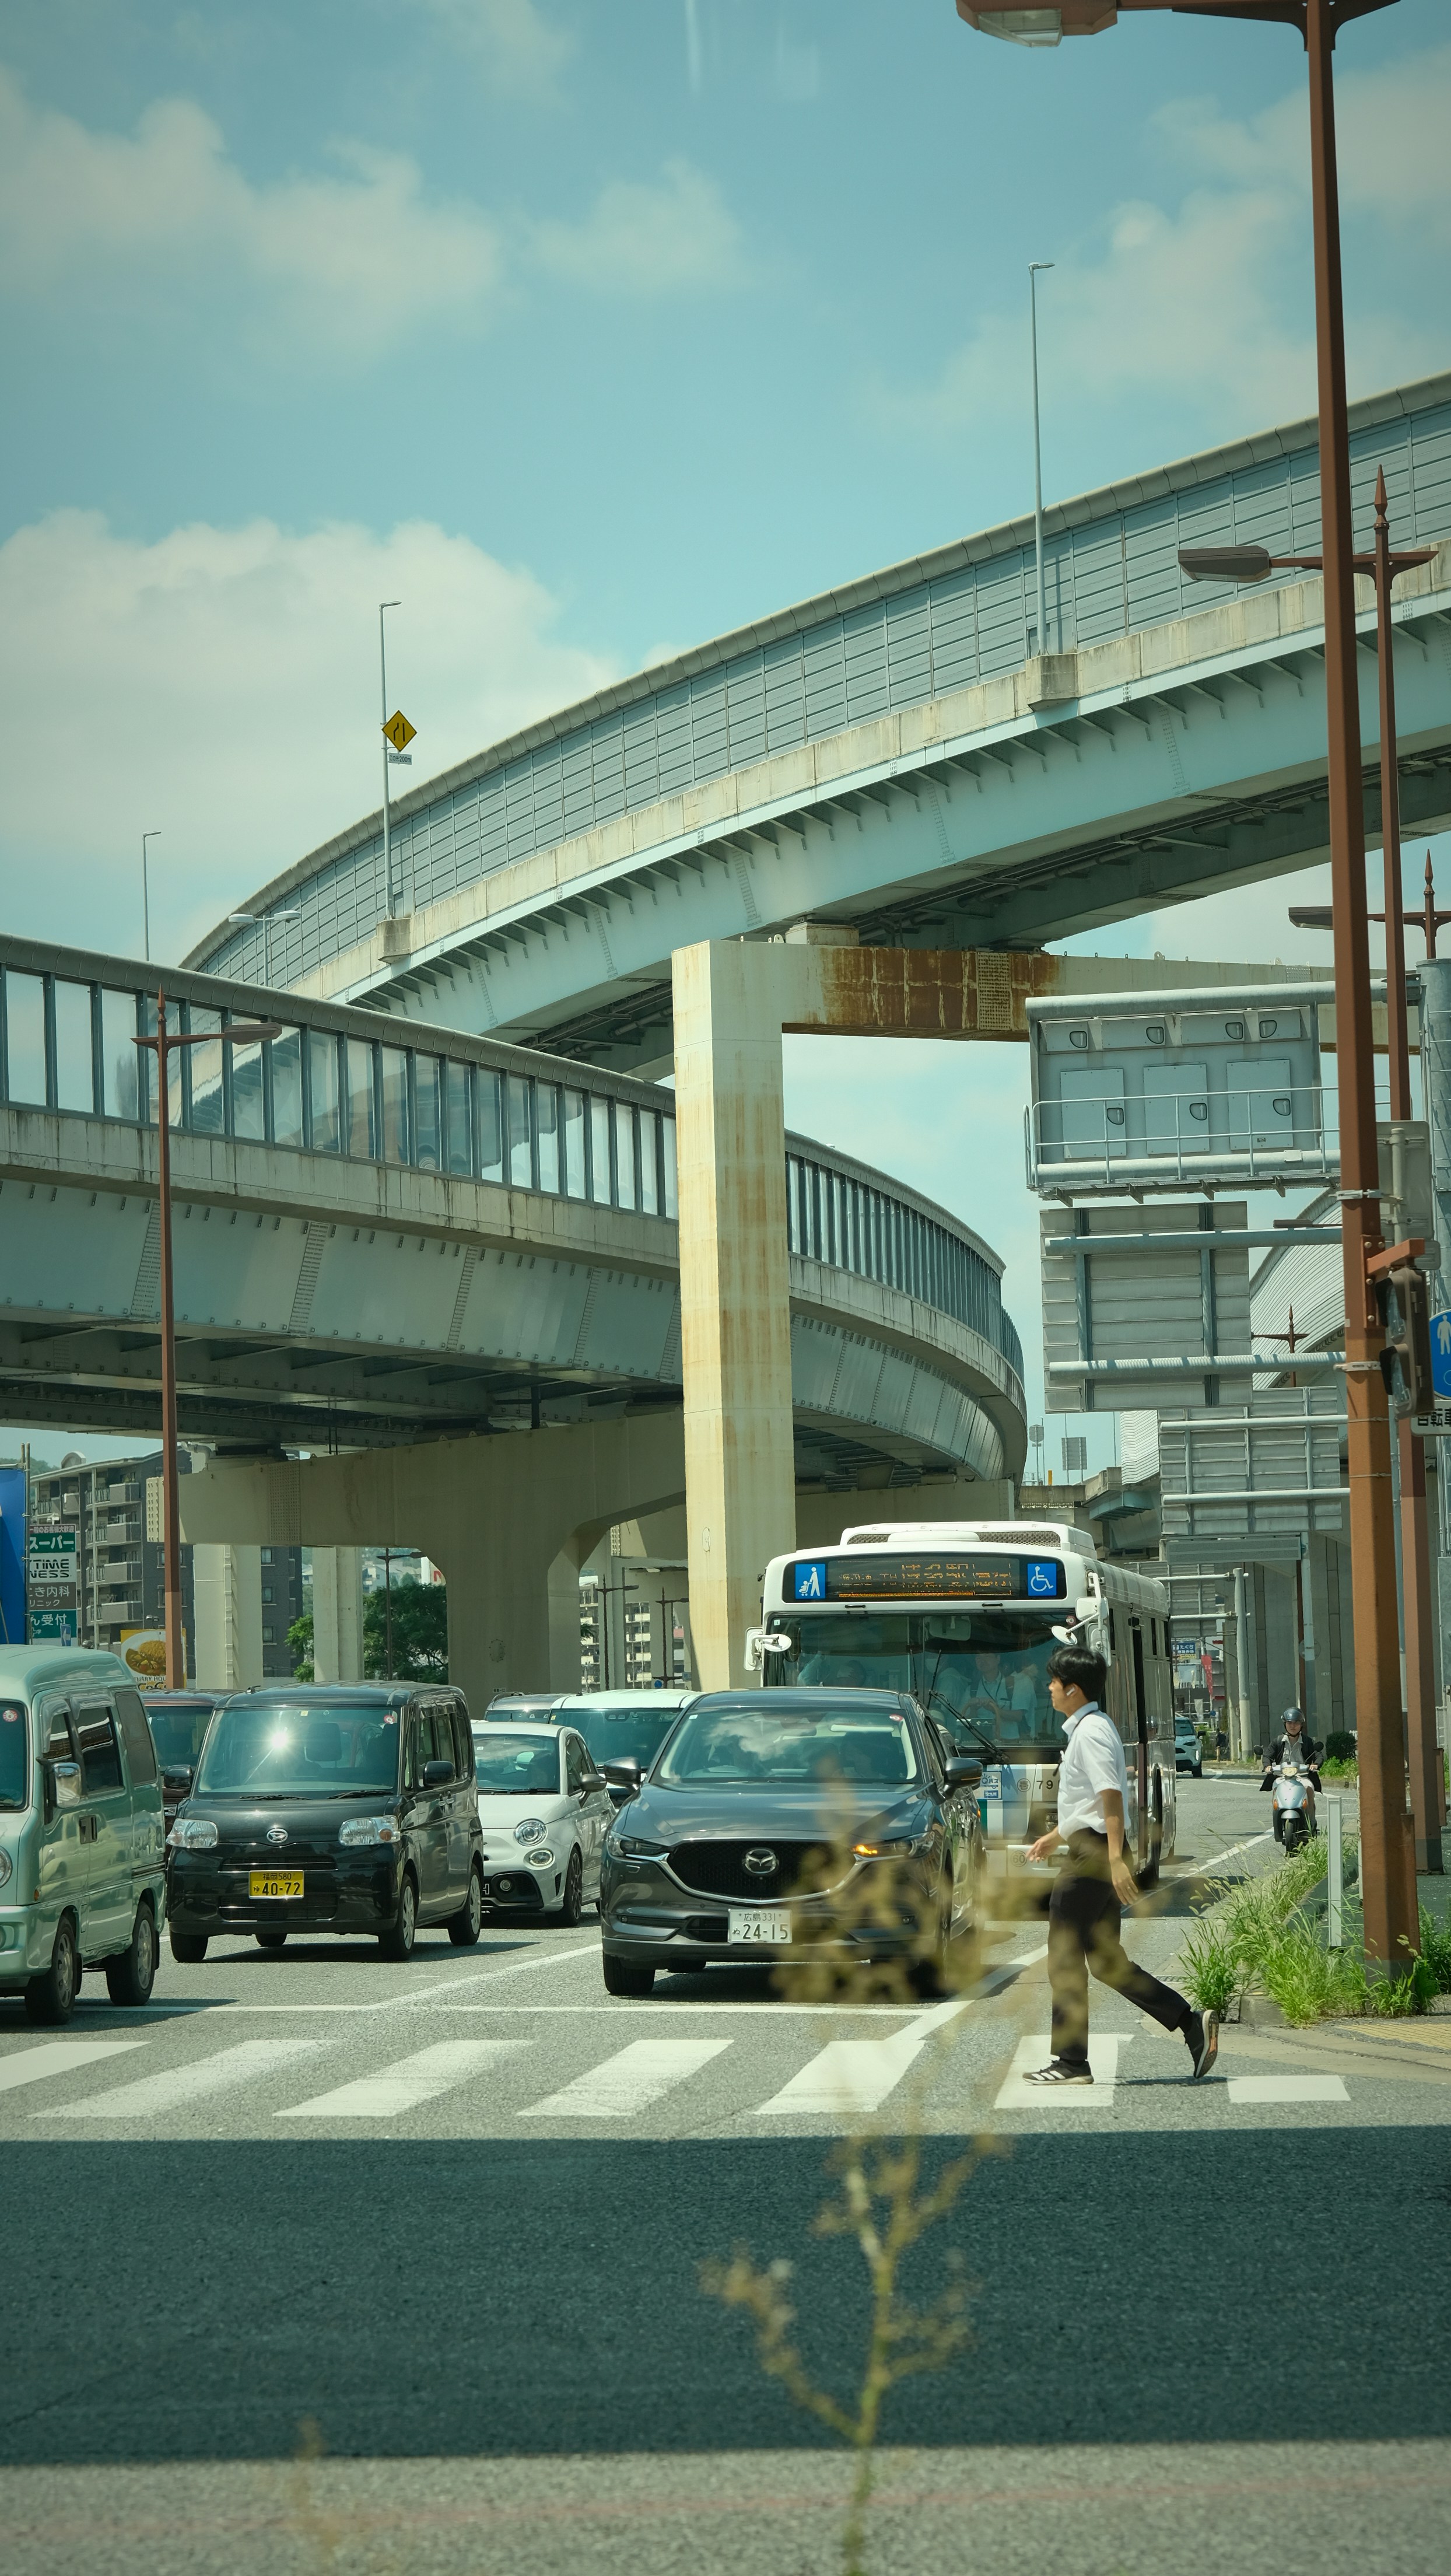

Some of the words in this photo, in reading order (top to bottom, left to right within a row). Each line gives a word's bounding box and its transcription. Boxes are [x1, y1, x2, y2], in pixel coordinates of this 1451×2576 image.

[30, 1535, 74, 1549] スーパー
[30, 1559, 69, 1569] TIME
[1036, 1780, 1060, 1790] 79
[262, 1882, 300, 1895] 40-72
[742, 1923, 788, 1940] 24-15
